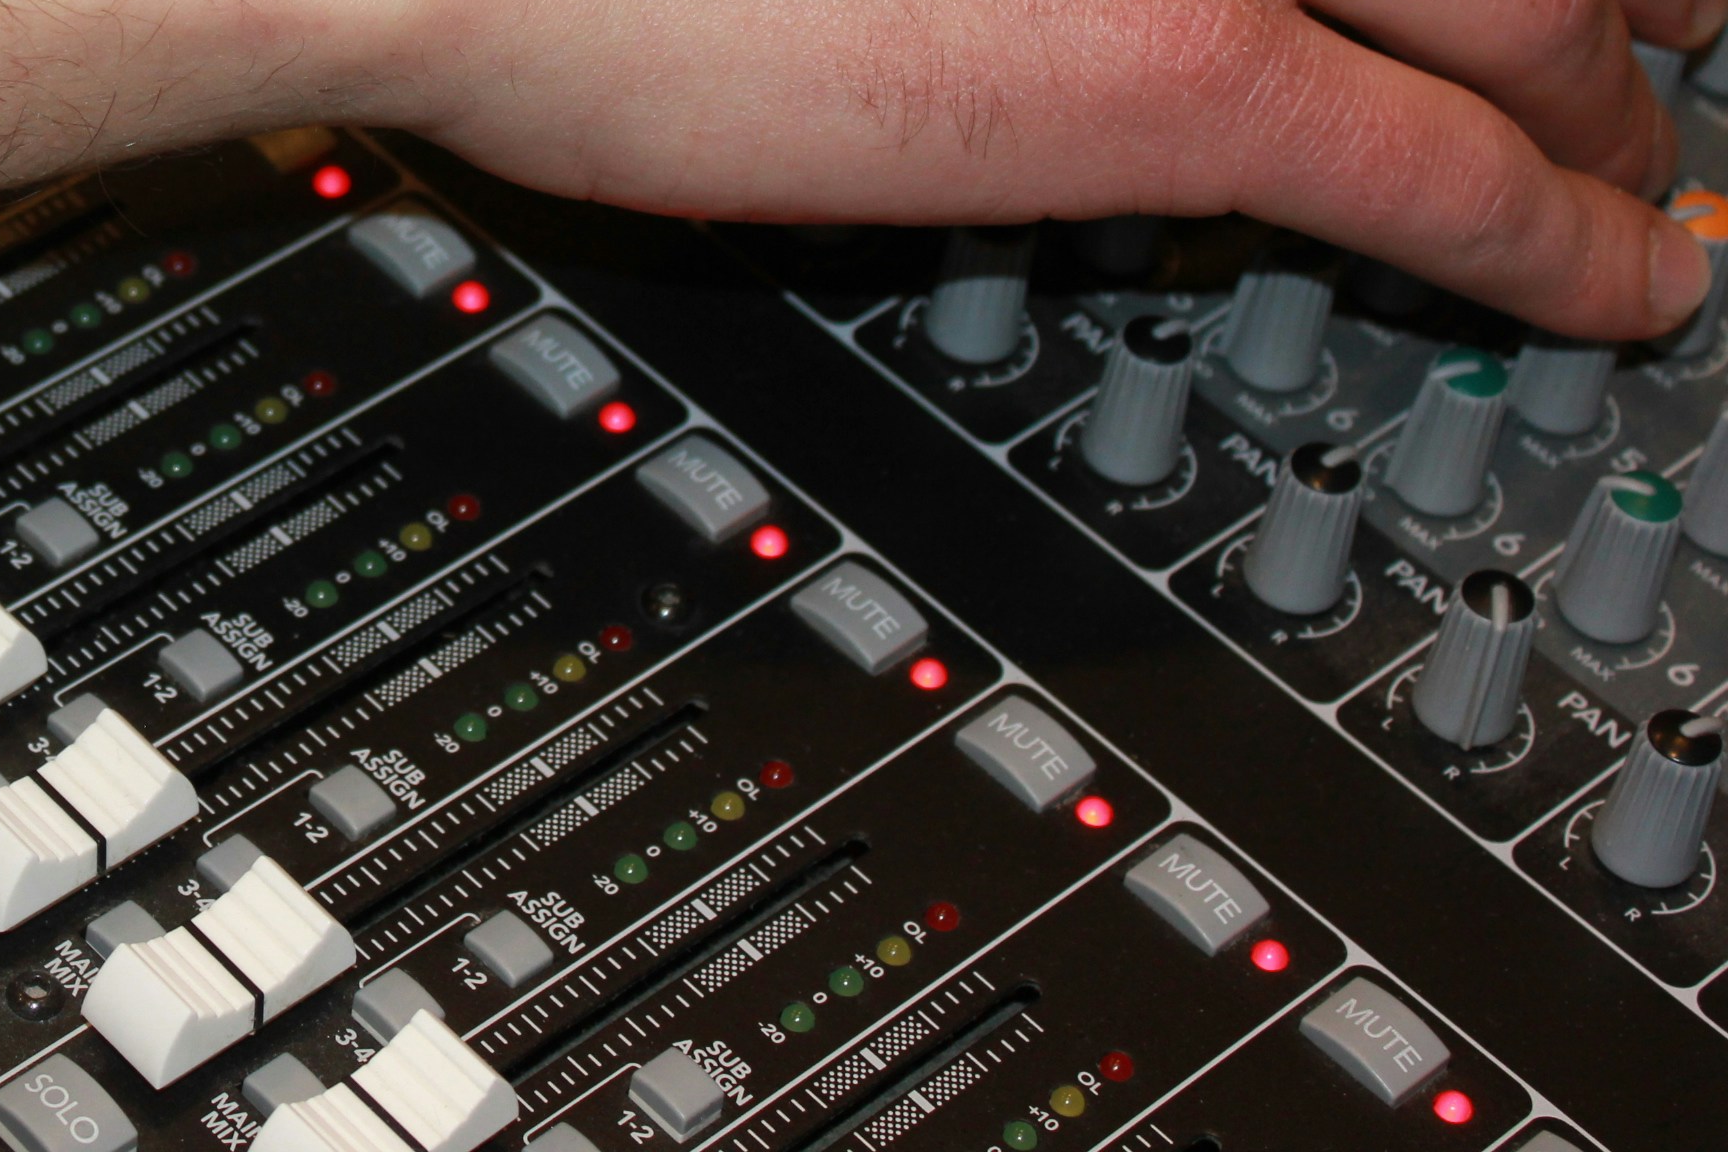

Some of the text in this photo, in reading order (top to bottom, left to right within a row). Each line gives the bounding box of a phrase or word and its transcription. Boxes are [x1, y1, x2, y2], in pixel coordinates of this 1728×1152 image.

[521, 329, 593, 390] MUTE
[1327, 408, 1359, 430] 6
[668, 451, 742, 510] MUTE
[57, 481, 127, 539] ASSIGN
[88, 483, 129, 517] SUB
[425, 510, 450, 533] OL
[1398, 516, 1442, 549] MAX
[378, 538, 407, 562] +10
[1493, 534, 1525, 556] 6
[335, 571, 351, 584] 0
[1385, 559, 1449, 614] PAN
[282, 598, 309, 618] -20
[822, 577, 901, 639] MUTE
[200, 612, 274, 672] ASSIGN
[232, 613, 274, 648] SUB
[578, 640, 601, 664] OL
[1571, 646, 1616, 682] MAX
[143, 672, 178, 704] 1-2
[529, 670, 559, 694] +10
[1667, 664, 1700, 686] 6
[487, 705, 502, 717] 0
[1381, 716, 1395, 731] L
[1558, 691, 1632, 748] PAN
[433, 732, 460, 753] -20
[988, 713, 1068, 780] MUTE
[350, 748, 426, 810] ASSIGN
[382, 749, 426, 786] SUB
[1443, 765, 1460, 780] R
[737, 778, 760, 801] OL
[293, 812, 329, 844] 1-2
[688, 809, 718, 833] +10
[646, 846, 661, 857] 0
[1559, 857, 1571, 870] L
[592, 874, 619, 895] -20
[1158, 853, 1242, 925] MUTE
[507, 891, 586, 955] ASSIGN
[540, 891, 585, 929] SUB
[1624, 907, 1642, 922] R
[903, 921, 927, 944] OL
[55, 940, 99, 981] MAI
[451, 957, 488, 990] 1-2
[854, 953, 884, 978] +10
[44, 957, 89, 997] MIX
[813, 992, 827, 1004] 0
[335, 1028, 376, 1063] 3-4
[758, 1021, 786, 1044] -20
[1336, 999, 1423, 1072] MUTE
[672, 1039, 754, 1106] ASSIGN
[706, 1040, 752, 1079] SUB
[1077, 1071, 1102, 1096] OL
[24, 1074, 99, 1143] SOLO
[1028, 1105, 1059, 1131] +10
[200, 1110, 247, 1151] MIX
[617, 1110, 655, 1145] 1-2
